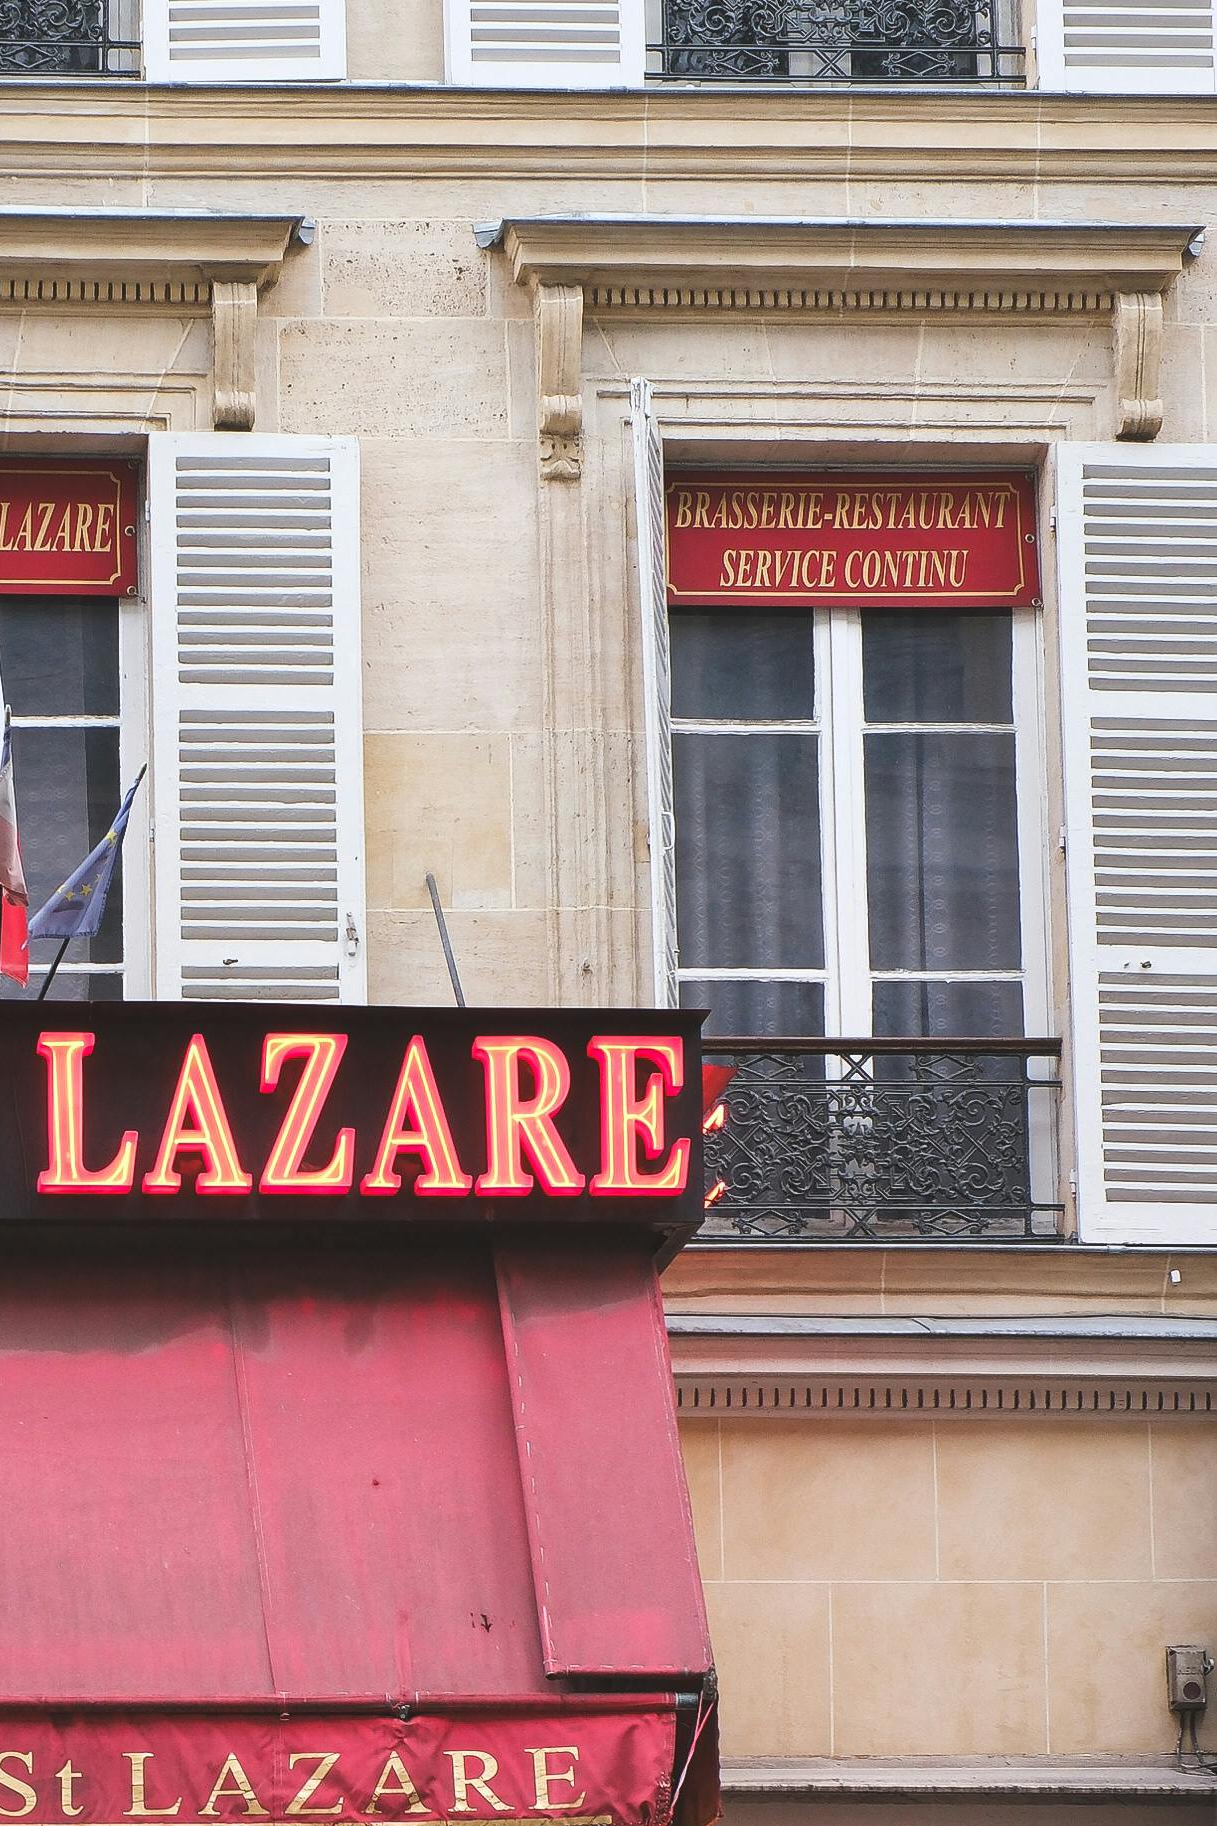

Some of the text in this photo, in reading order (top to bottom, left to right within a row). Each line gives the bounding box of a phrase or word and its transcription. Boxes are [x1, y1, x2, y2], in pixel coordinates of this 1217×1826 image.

[674, 491, 1011, 529] BRASSERIE-RESTAURANT
[719, 549, 969, 588] SERVICE CONTINU
[37, 1032, 691, 1196] LAZARE
[122, 1746, 586, 1816] LAZARE
